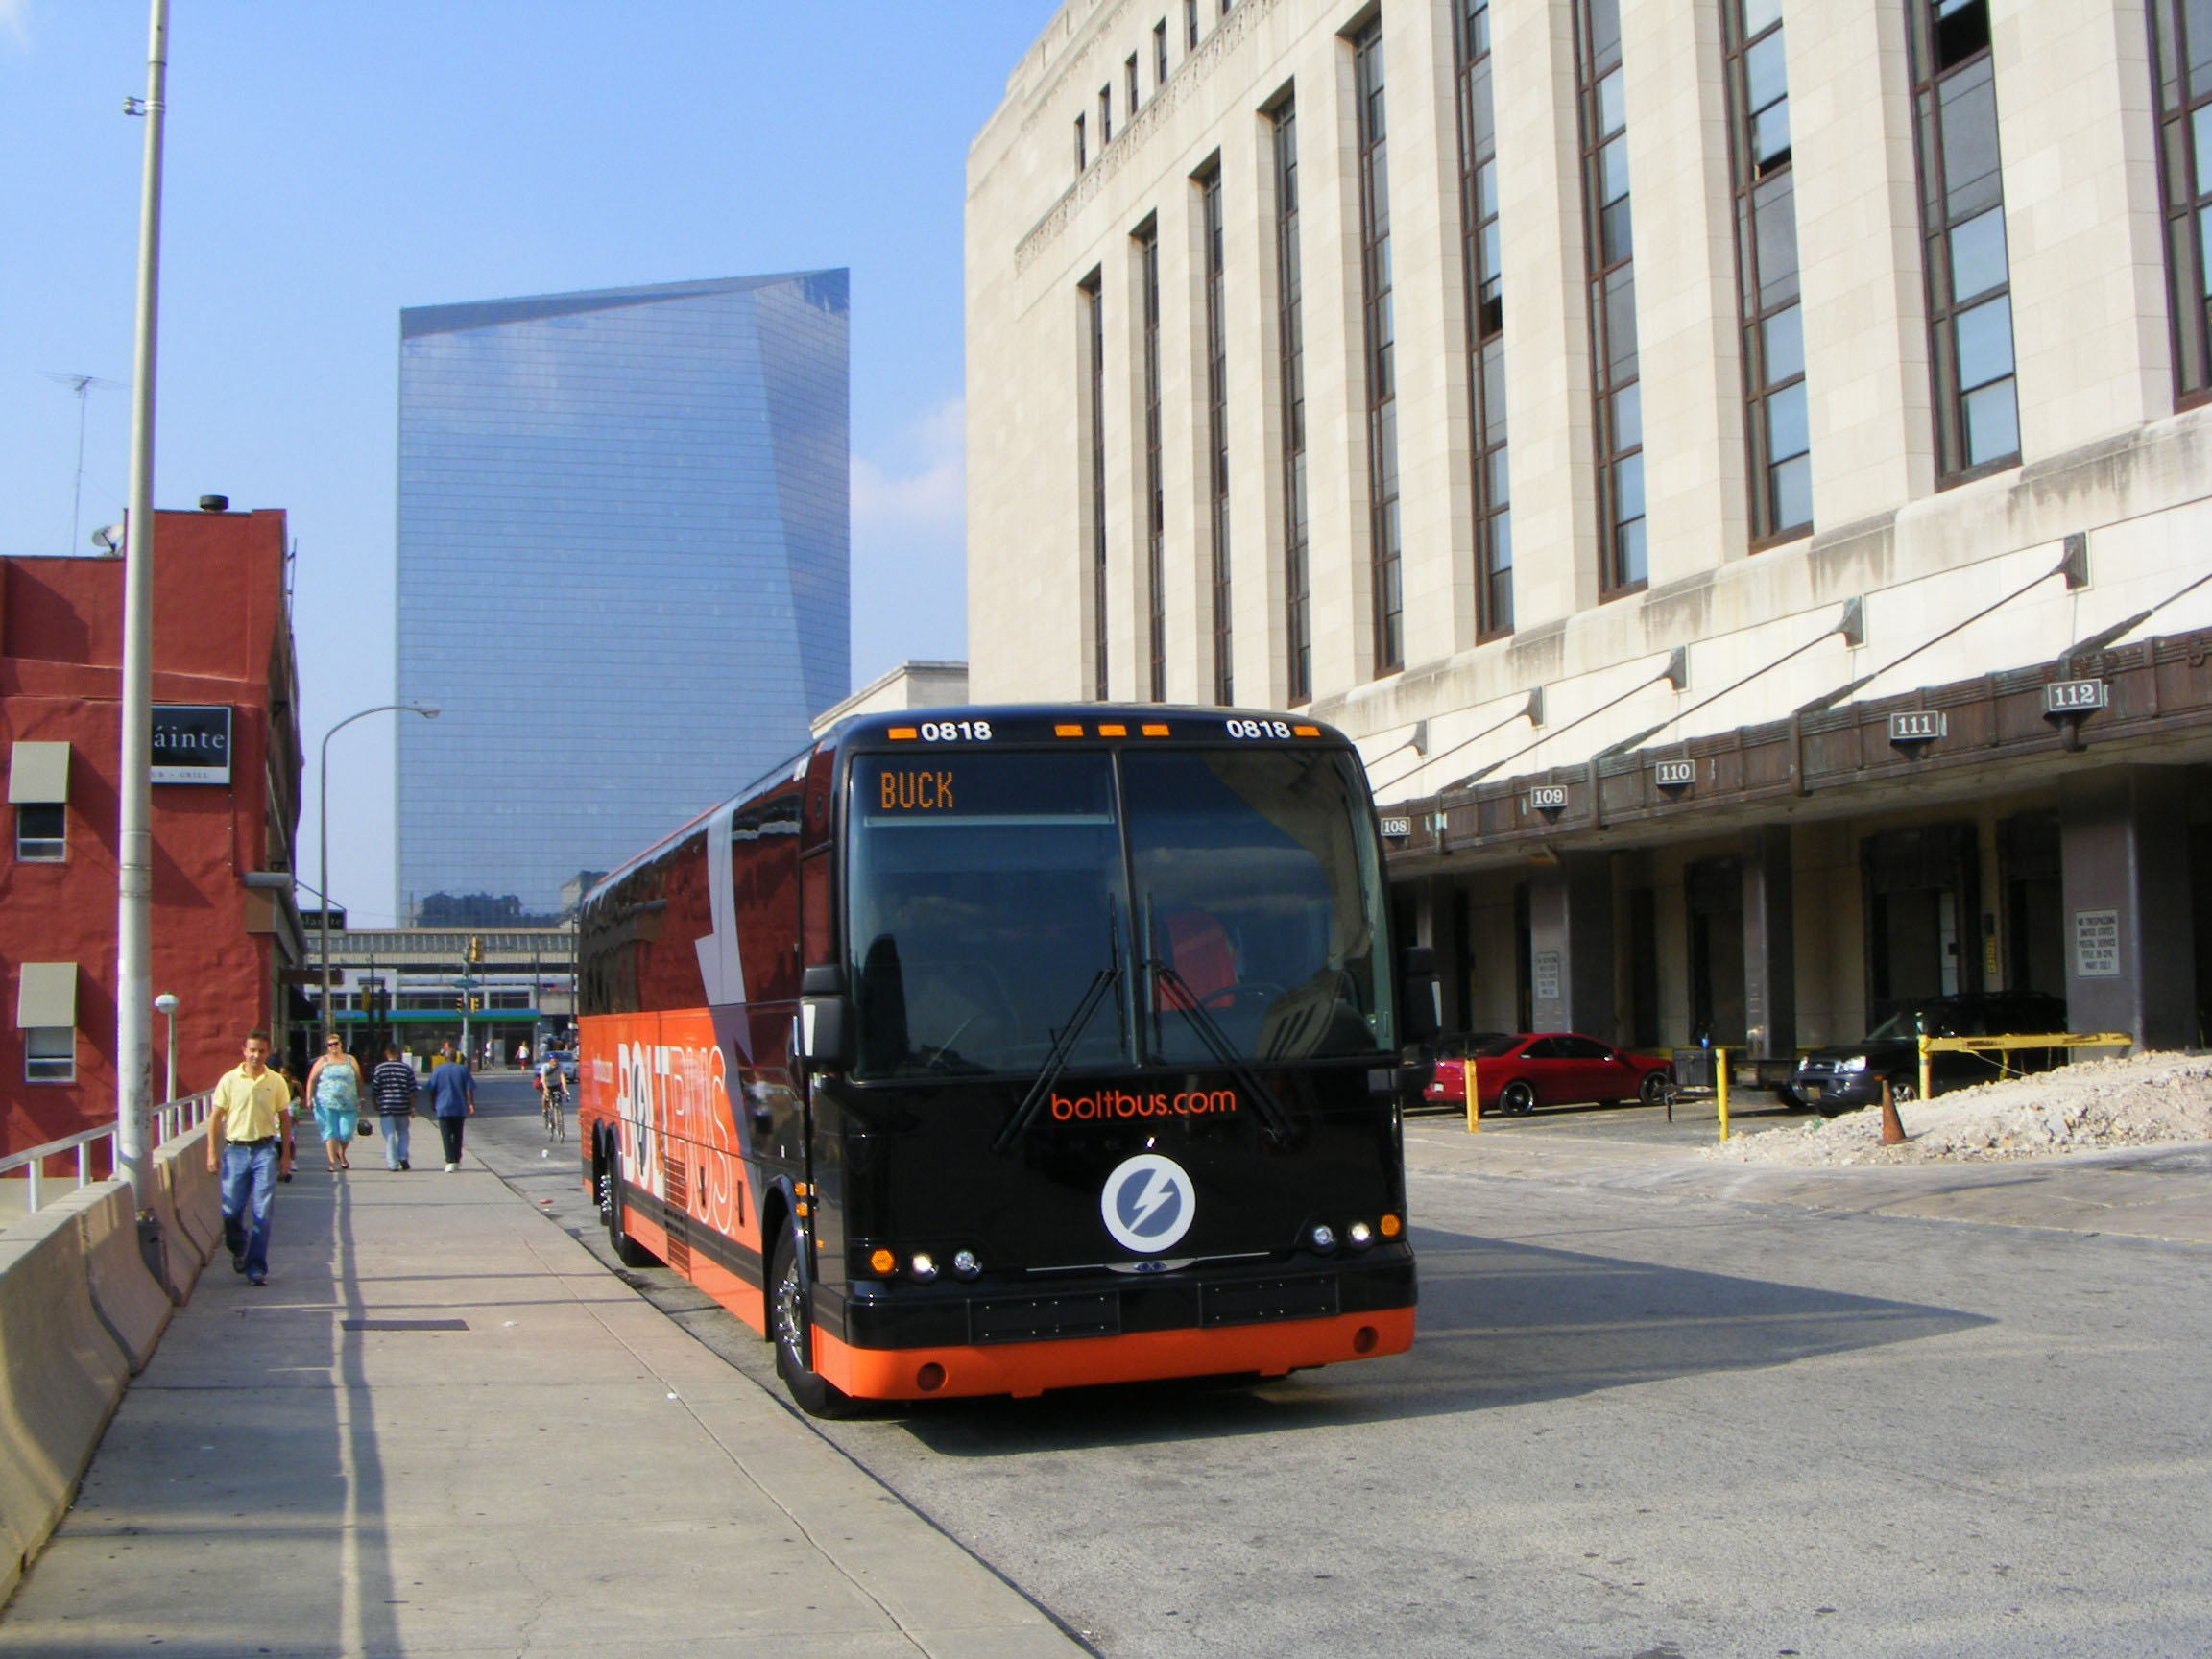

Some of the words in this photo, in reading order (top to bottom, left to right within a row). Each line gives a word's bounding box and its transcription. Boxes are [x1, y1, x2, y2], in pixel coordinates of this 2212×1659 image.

[2055, 684, 2095, 707] 112
[921, 720, 993, 741] 0818
[1226, 720, 1291, 739] 0818
[1898, 714, 1932, 735] 111
[154, 725, 225, 749] áinte
[1661, 764, 1690, 781] 110
[880, 771, 953, 808] BUCK
[1535, 789, 1563, 805] 109
[1383, 819, 1407, 834] 108
[1051, 1089, 1237, 1120] boltbus.com
